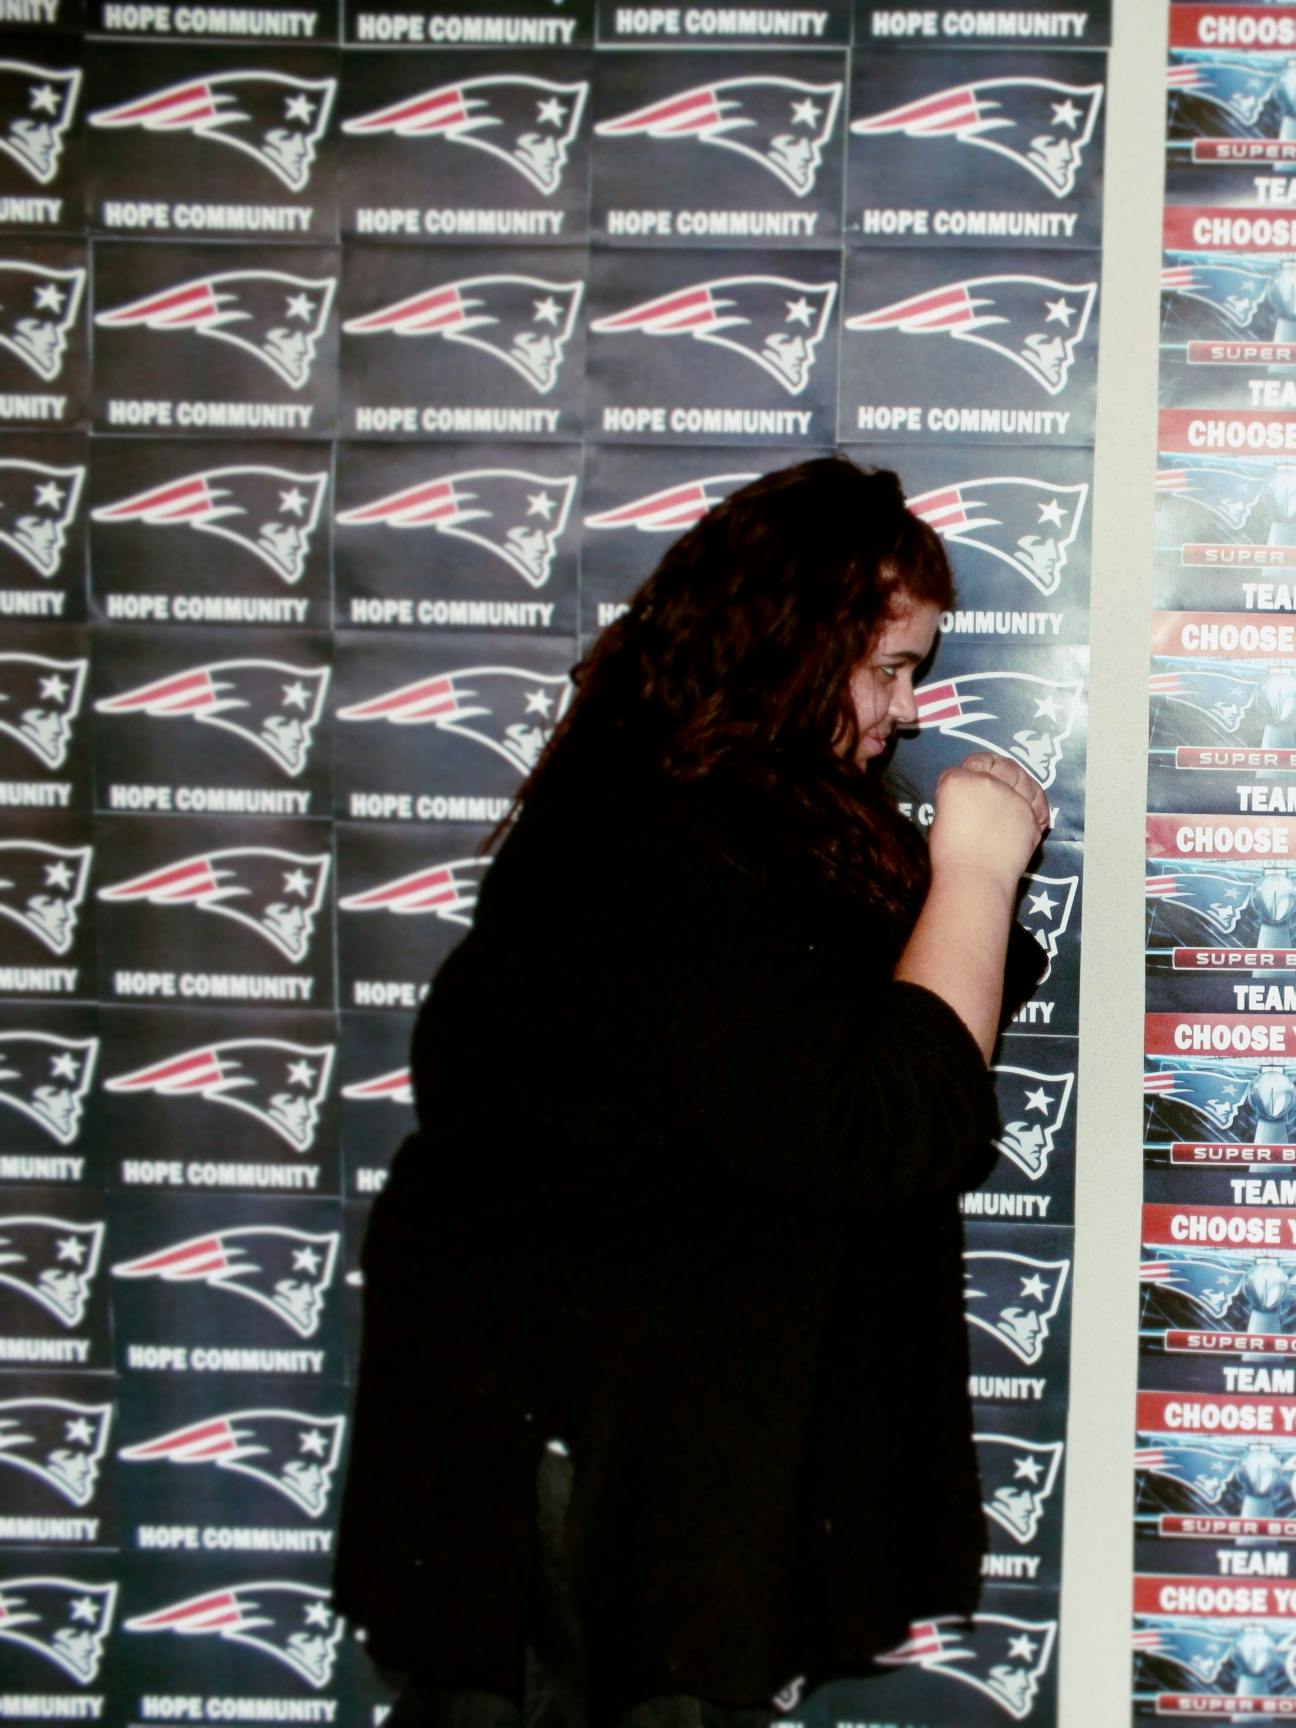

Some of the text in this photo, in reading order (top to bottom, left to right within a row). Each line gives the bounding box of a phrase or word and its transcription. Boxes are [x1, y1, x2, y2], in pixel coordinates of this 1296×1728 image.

[104, 4, 317, 36] HOPE COMMUNITY
[358, 15, 576, 44] HOPE COMMUNITY
[616, 9, 828, 35] HOPE COMMUNITY
[872, 11, 1087, 37] HOPE COMMUNITY
[103, 202, 313, 230] HOPE COMMUNITY
[357, 209, 563, 234] HOPE COMMUNITY
[608, 211, 817, 235] HOPE COMMUNITY
[864, 210, 1078, 236] HOPE COMMUNITY
[1210, 347, 1291, 361] SUPER
[108, 400, 313, 427] HOPE COMMUNITY
[356, 408, 559, 431] HOPE COMMUNITY
[603, 408, 812, 434] HOPE COMMUNITY
[858, 407, 1069, 432] HOPE COMMUNITY
[1205, 550, 1285, 564] SUPER
[0, 590, 65, 615] UNITY
[106, 594, 308, 622] HOPE COMMUNITY
[351, 599, 554, 626] HOPE COMMUNITY
[939, 610, 1064, 635] OMMUNITY
[1181, 624, 1295, 651] CHOOSE
[1200, 753, 1279, 767] SUPER
[111, 785, 310, 814] HOPE COMMUNITY
[350, 793, 412, 818] HOPE
[1176, 826, 1288, 853] CHOOSE
[1196, 953, 1275, 966] SUPER
[114, 971, 313, 1000] HOPE COMMUNITY
[354, 981, 416, 1006] HOPE
[1174, 1024, 1285, 1051] CHOOSE
[1194, 1148, 1272, 1160] SUPER
[0, 1155, 84, 1180] MUNITY
[122, 1160, 319, 1188] HOPE COMMUNITY
[959, 1192, 1051, 1217] MUNITY
[1171, 1215, 1281, 1243] CHOOSE
[1187, 1336, 1265, 1349] SUPER
[127, 1345, 324, 1373] HOPE COMMUNITY
[1223, 1367, 1295, 1394] TEAM
[1164, 1403, 1273, 1429] CHOOSE
[137, 1525, 333, 1552] HOPE COMMUNITY
[1181, 1519, 1259, 1533] SUPER
[1217, 1551, 1288, 1576] TEAM
[1159, 1586, 1268, 1613] CHOOSE
[141, 1695, 337, 1722] HOPE COMMUNITY
[1178, 1698, 1254, 1712] SUPER
